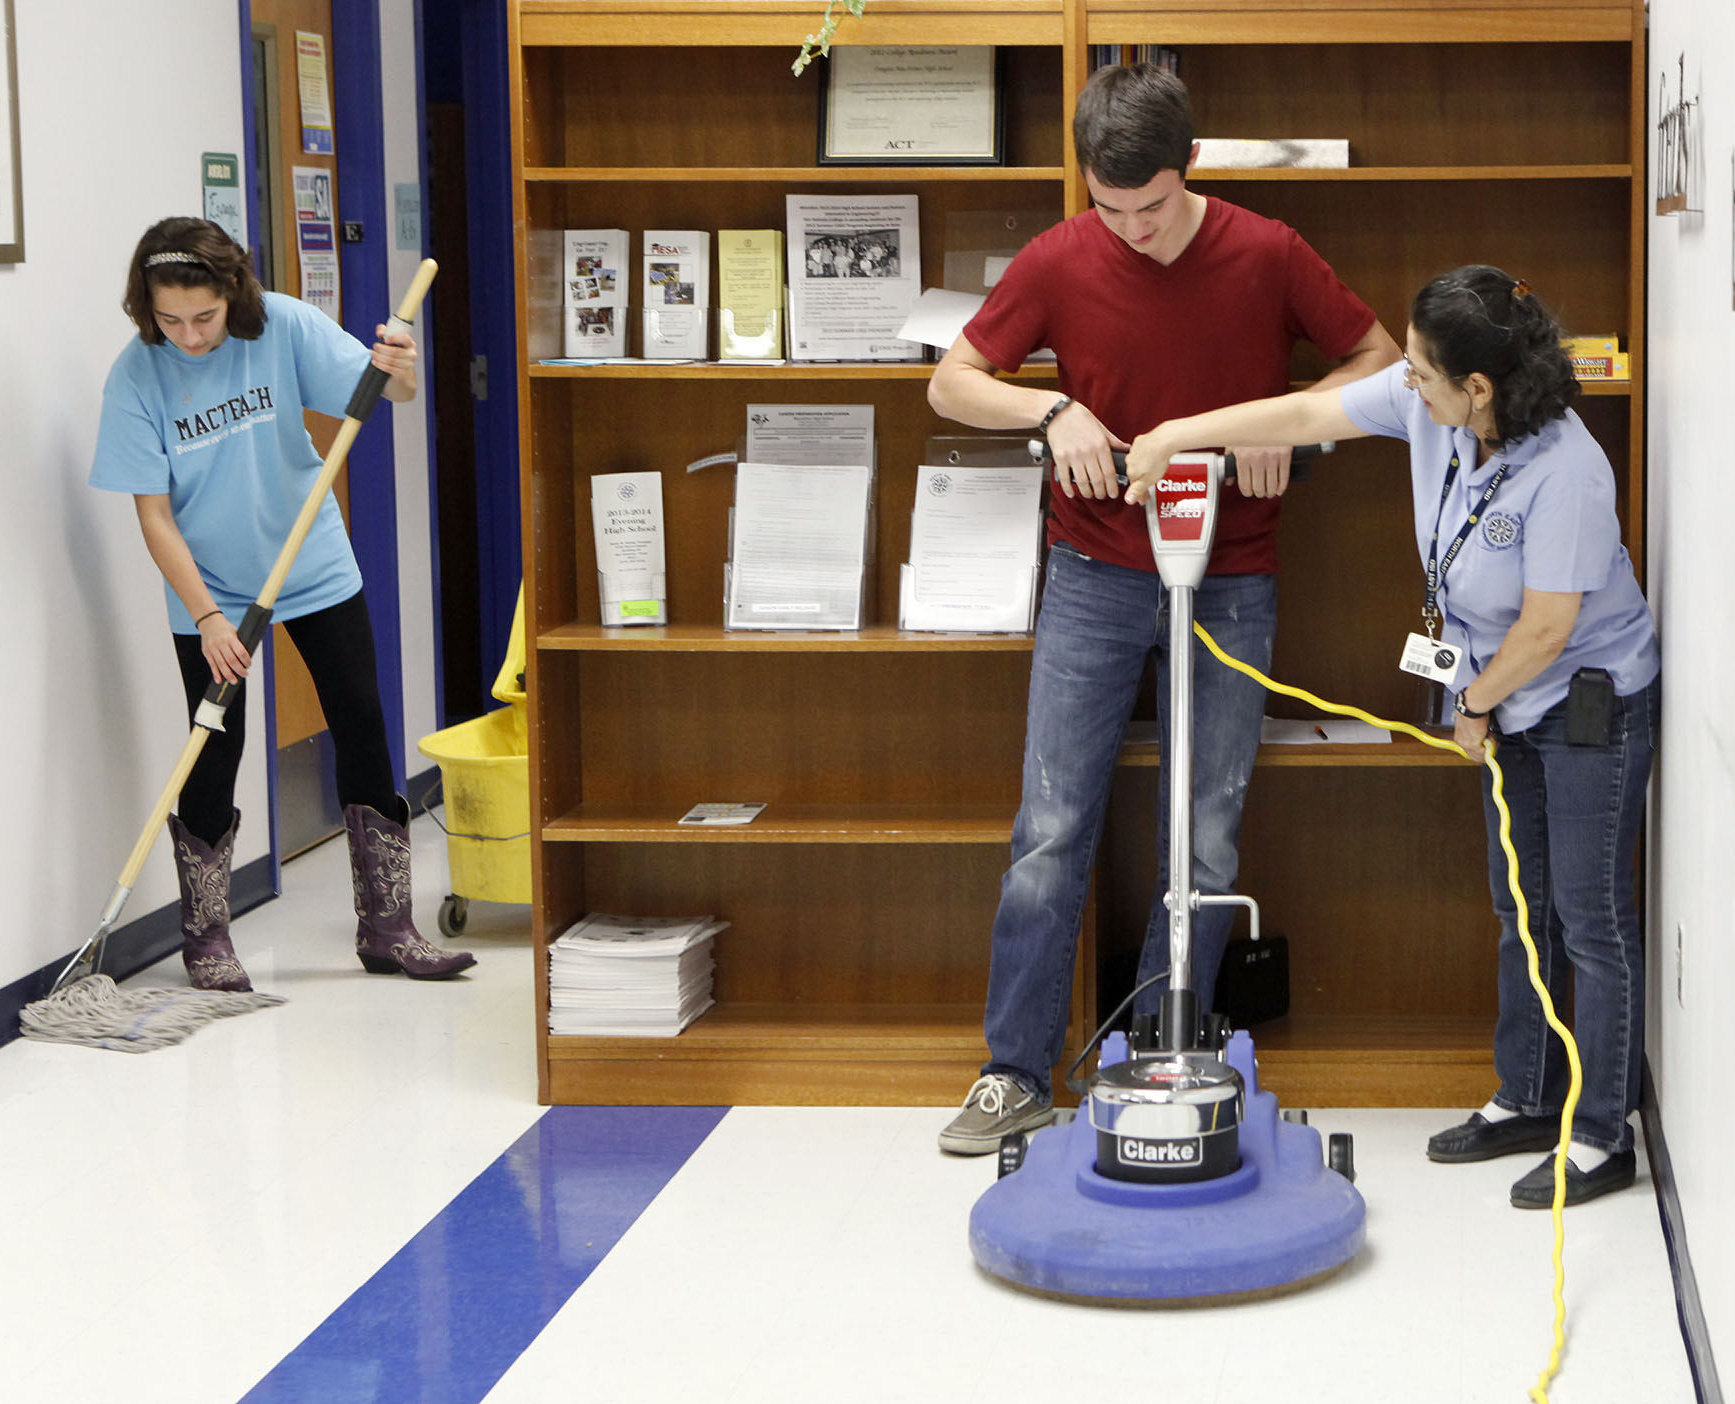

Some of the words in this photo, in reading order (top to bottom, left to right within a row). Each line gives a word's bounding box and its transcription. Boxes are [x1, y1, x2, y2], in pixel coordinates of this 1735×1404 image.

[884, 139, 915, 150] ACT
[1156, 479, 1206, 492] Clarke
[1159, 510, 1202, 518] SPEED
[611, 518, 646, 526] Evening
[604, 526, 626, 535] High
[627, 525, 657, 533] School
[1123, 1139, 1195, 1161] Clarke
